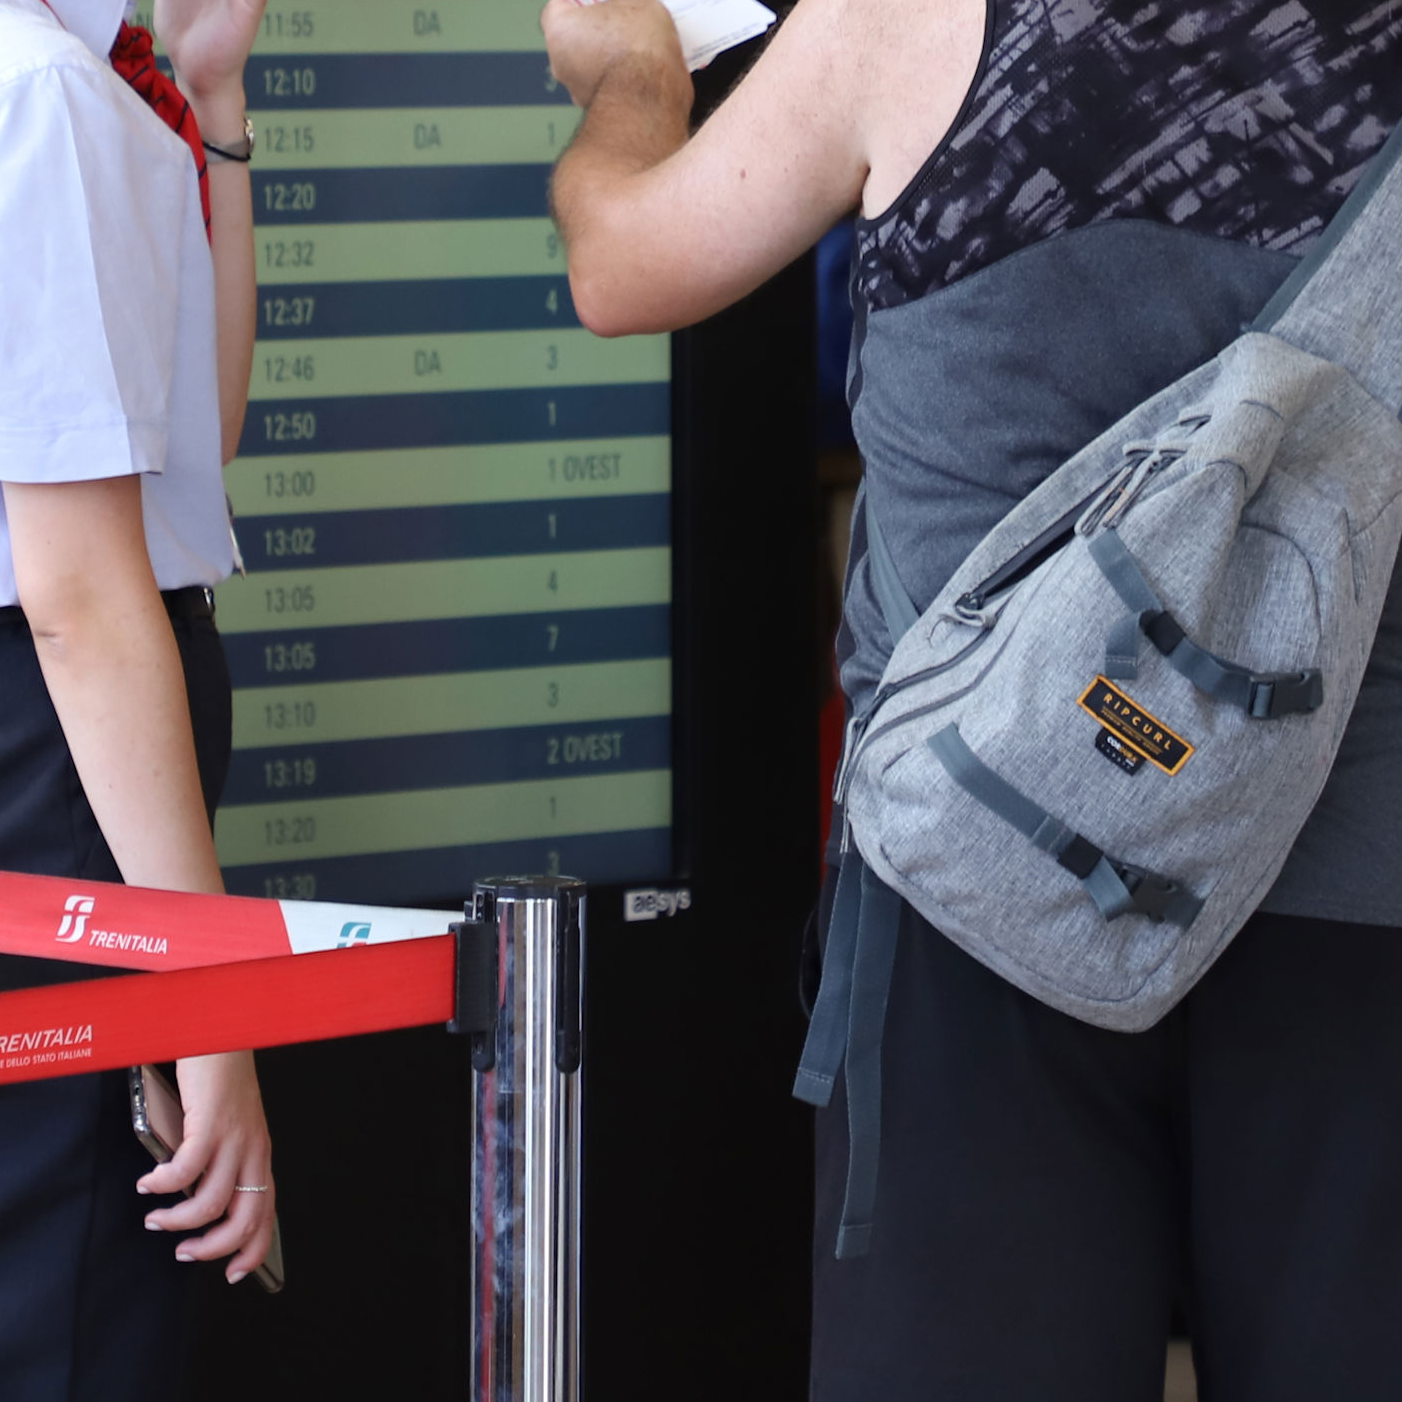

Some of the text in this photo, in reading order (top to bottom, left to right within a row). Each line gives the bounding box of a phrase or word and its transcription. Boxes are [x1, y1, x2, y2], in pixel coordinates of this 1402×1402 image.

[264, 10, 442, 38] 11:55 DA
[264, 68, 316, 95] 12:10
[264, 126, 315, 153] 12:15
[413, 123, 442, 150] DA
[264, 183, 316, 211] 12:20
[264, 241, 315, 268] 12:32
[264, 297, 315, 326] 12:37
[264, 344, 558, 383] 12:46 DA 3
[264, 401, 556, 441] 12:50 1
[264, 471, 315, 498] 13:00
[563, 453, 621, 482] OVEST
[264, 514, 556, 556] 13:02 1
[264, 586, 315, 613] 13:05
[264, 626, 559, 671] 13:05 7
[264, 702, 316, 730] 13:10
[264, 732, 623, 787] 13:19 2 OVEST
[264, 817, 316, 846] 13:20
[88, 929, 168, 955] TRENITALIA
[6, 1055, 31, 1069] DELLO
[32, 1051, 57, 1064] STATO
[58, 1047, 93, 1061] ITALIANE
